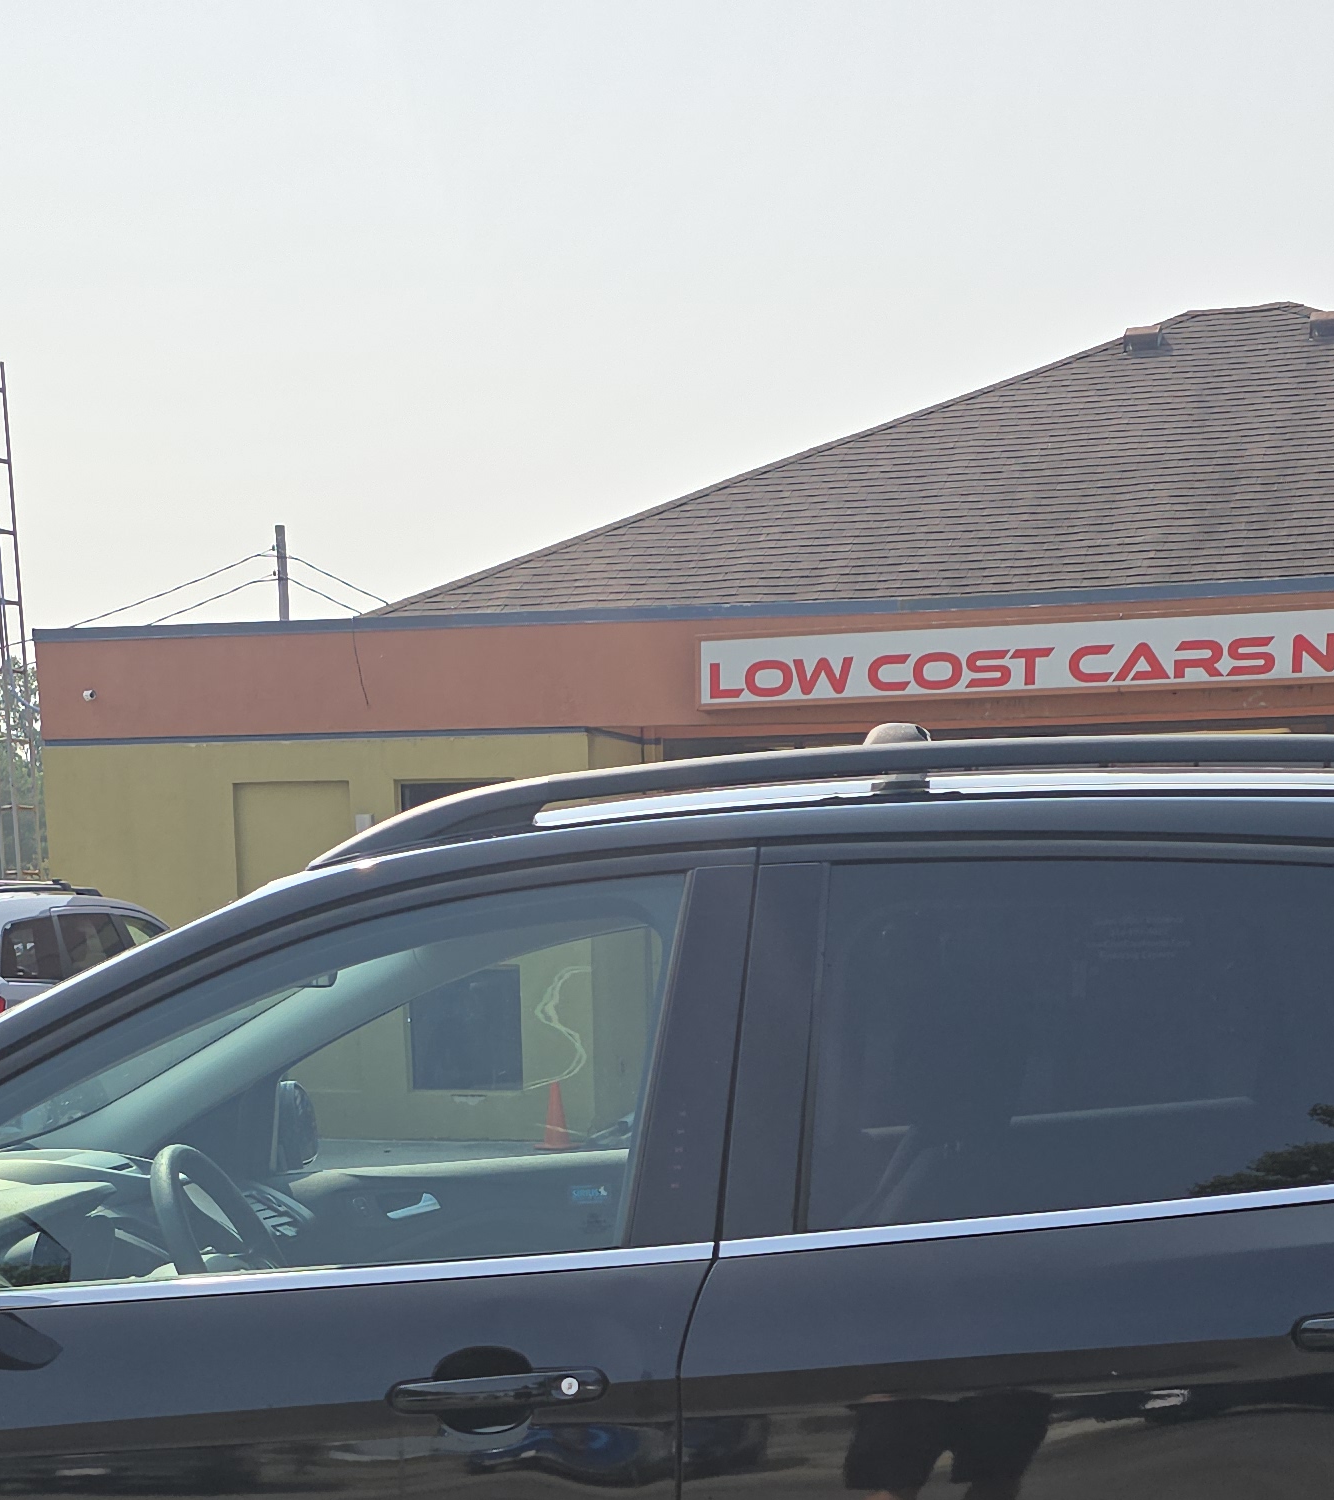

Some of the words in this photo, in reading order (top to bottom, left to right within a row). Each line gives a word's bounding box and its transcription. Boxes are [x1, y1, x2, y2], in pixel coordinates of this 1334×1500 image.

[709, 657, 853, 699] LOW
[867, 646, 1055, 691] COST
[1068, 636, 1275, 683] CARS
